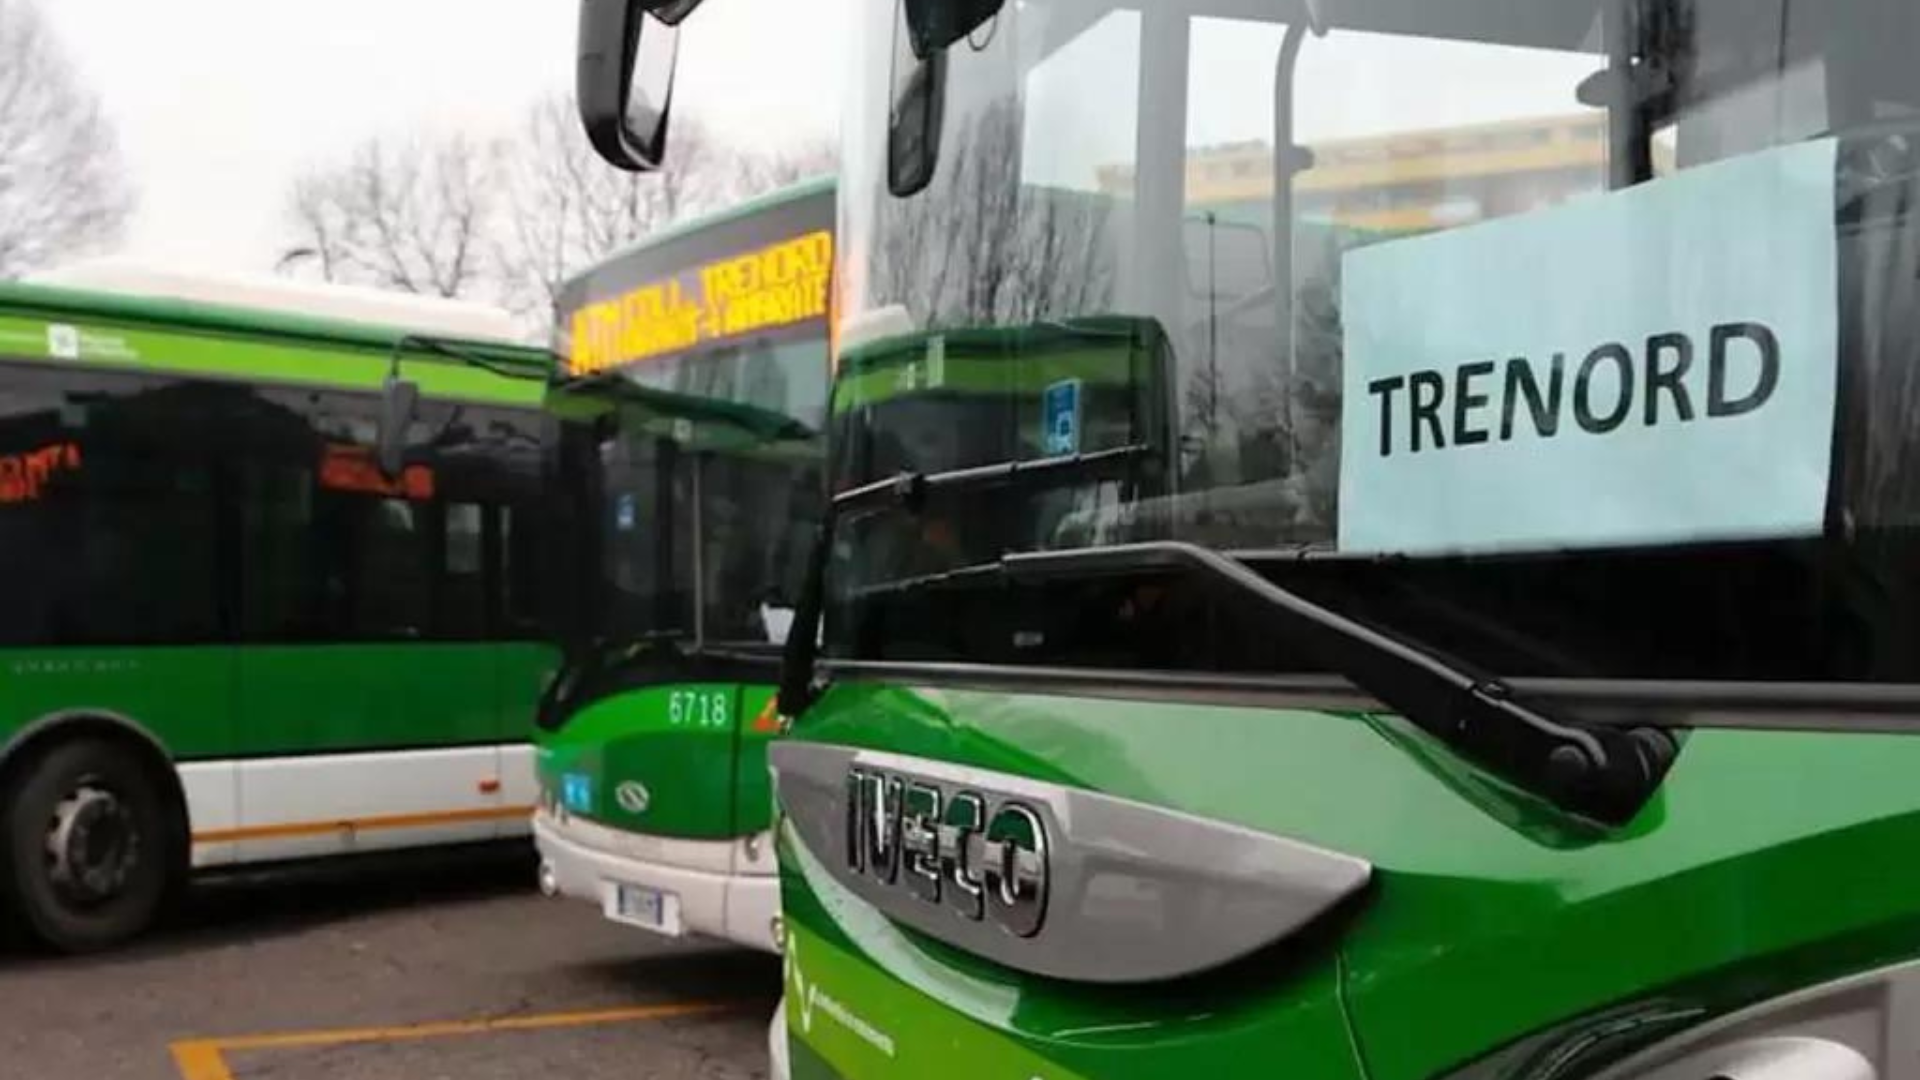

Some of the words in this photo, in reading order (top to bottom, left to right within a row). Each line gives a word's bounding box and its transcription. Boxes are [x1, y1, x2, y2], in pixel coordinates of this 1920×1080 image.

[1368, 322, 1780, 456] TRENORD
[668, 691, 727, 726] 6718
[846, 768, 1050, 939] IVECO
